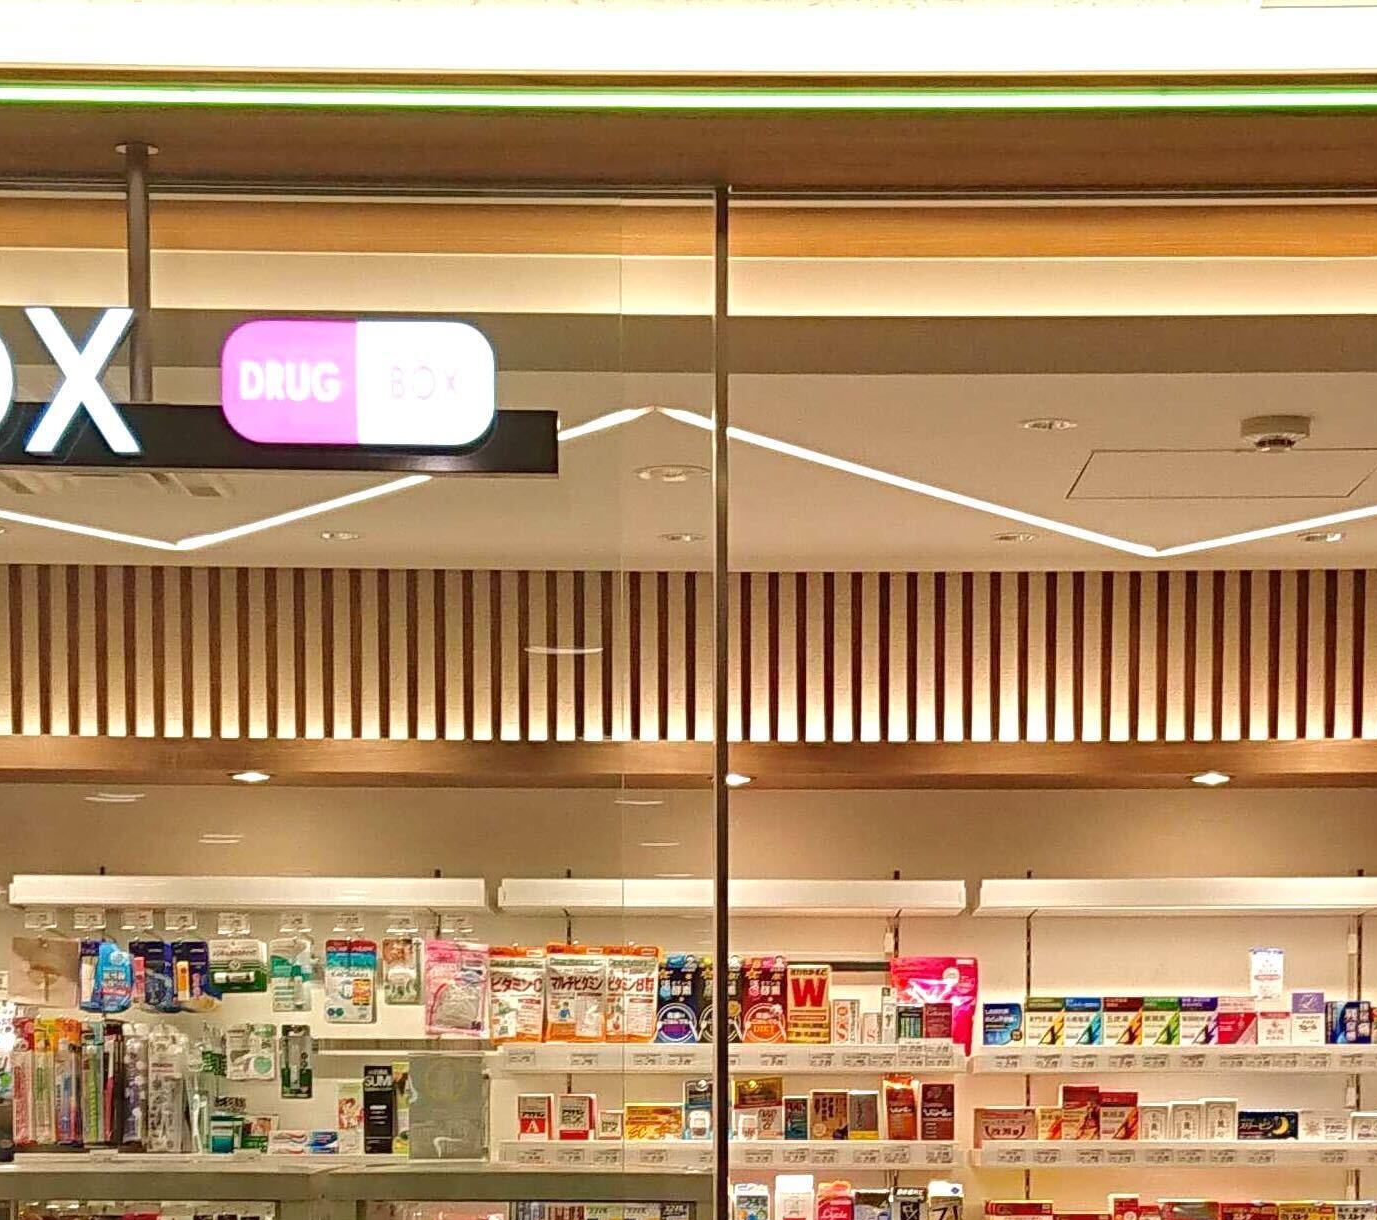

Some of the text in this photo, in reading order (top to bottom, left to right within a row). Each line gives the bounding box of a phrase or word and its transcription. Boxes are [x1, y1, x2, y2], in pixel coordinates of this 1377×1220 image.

[238, 359, 460, 402] DRUG BOX
[490, 975, 543, 993] ビタミンC
[551, 975, 603, 991] マルチビタミン
